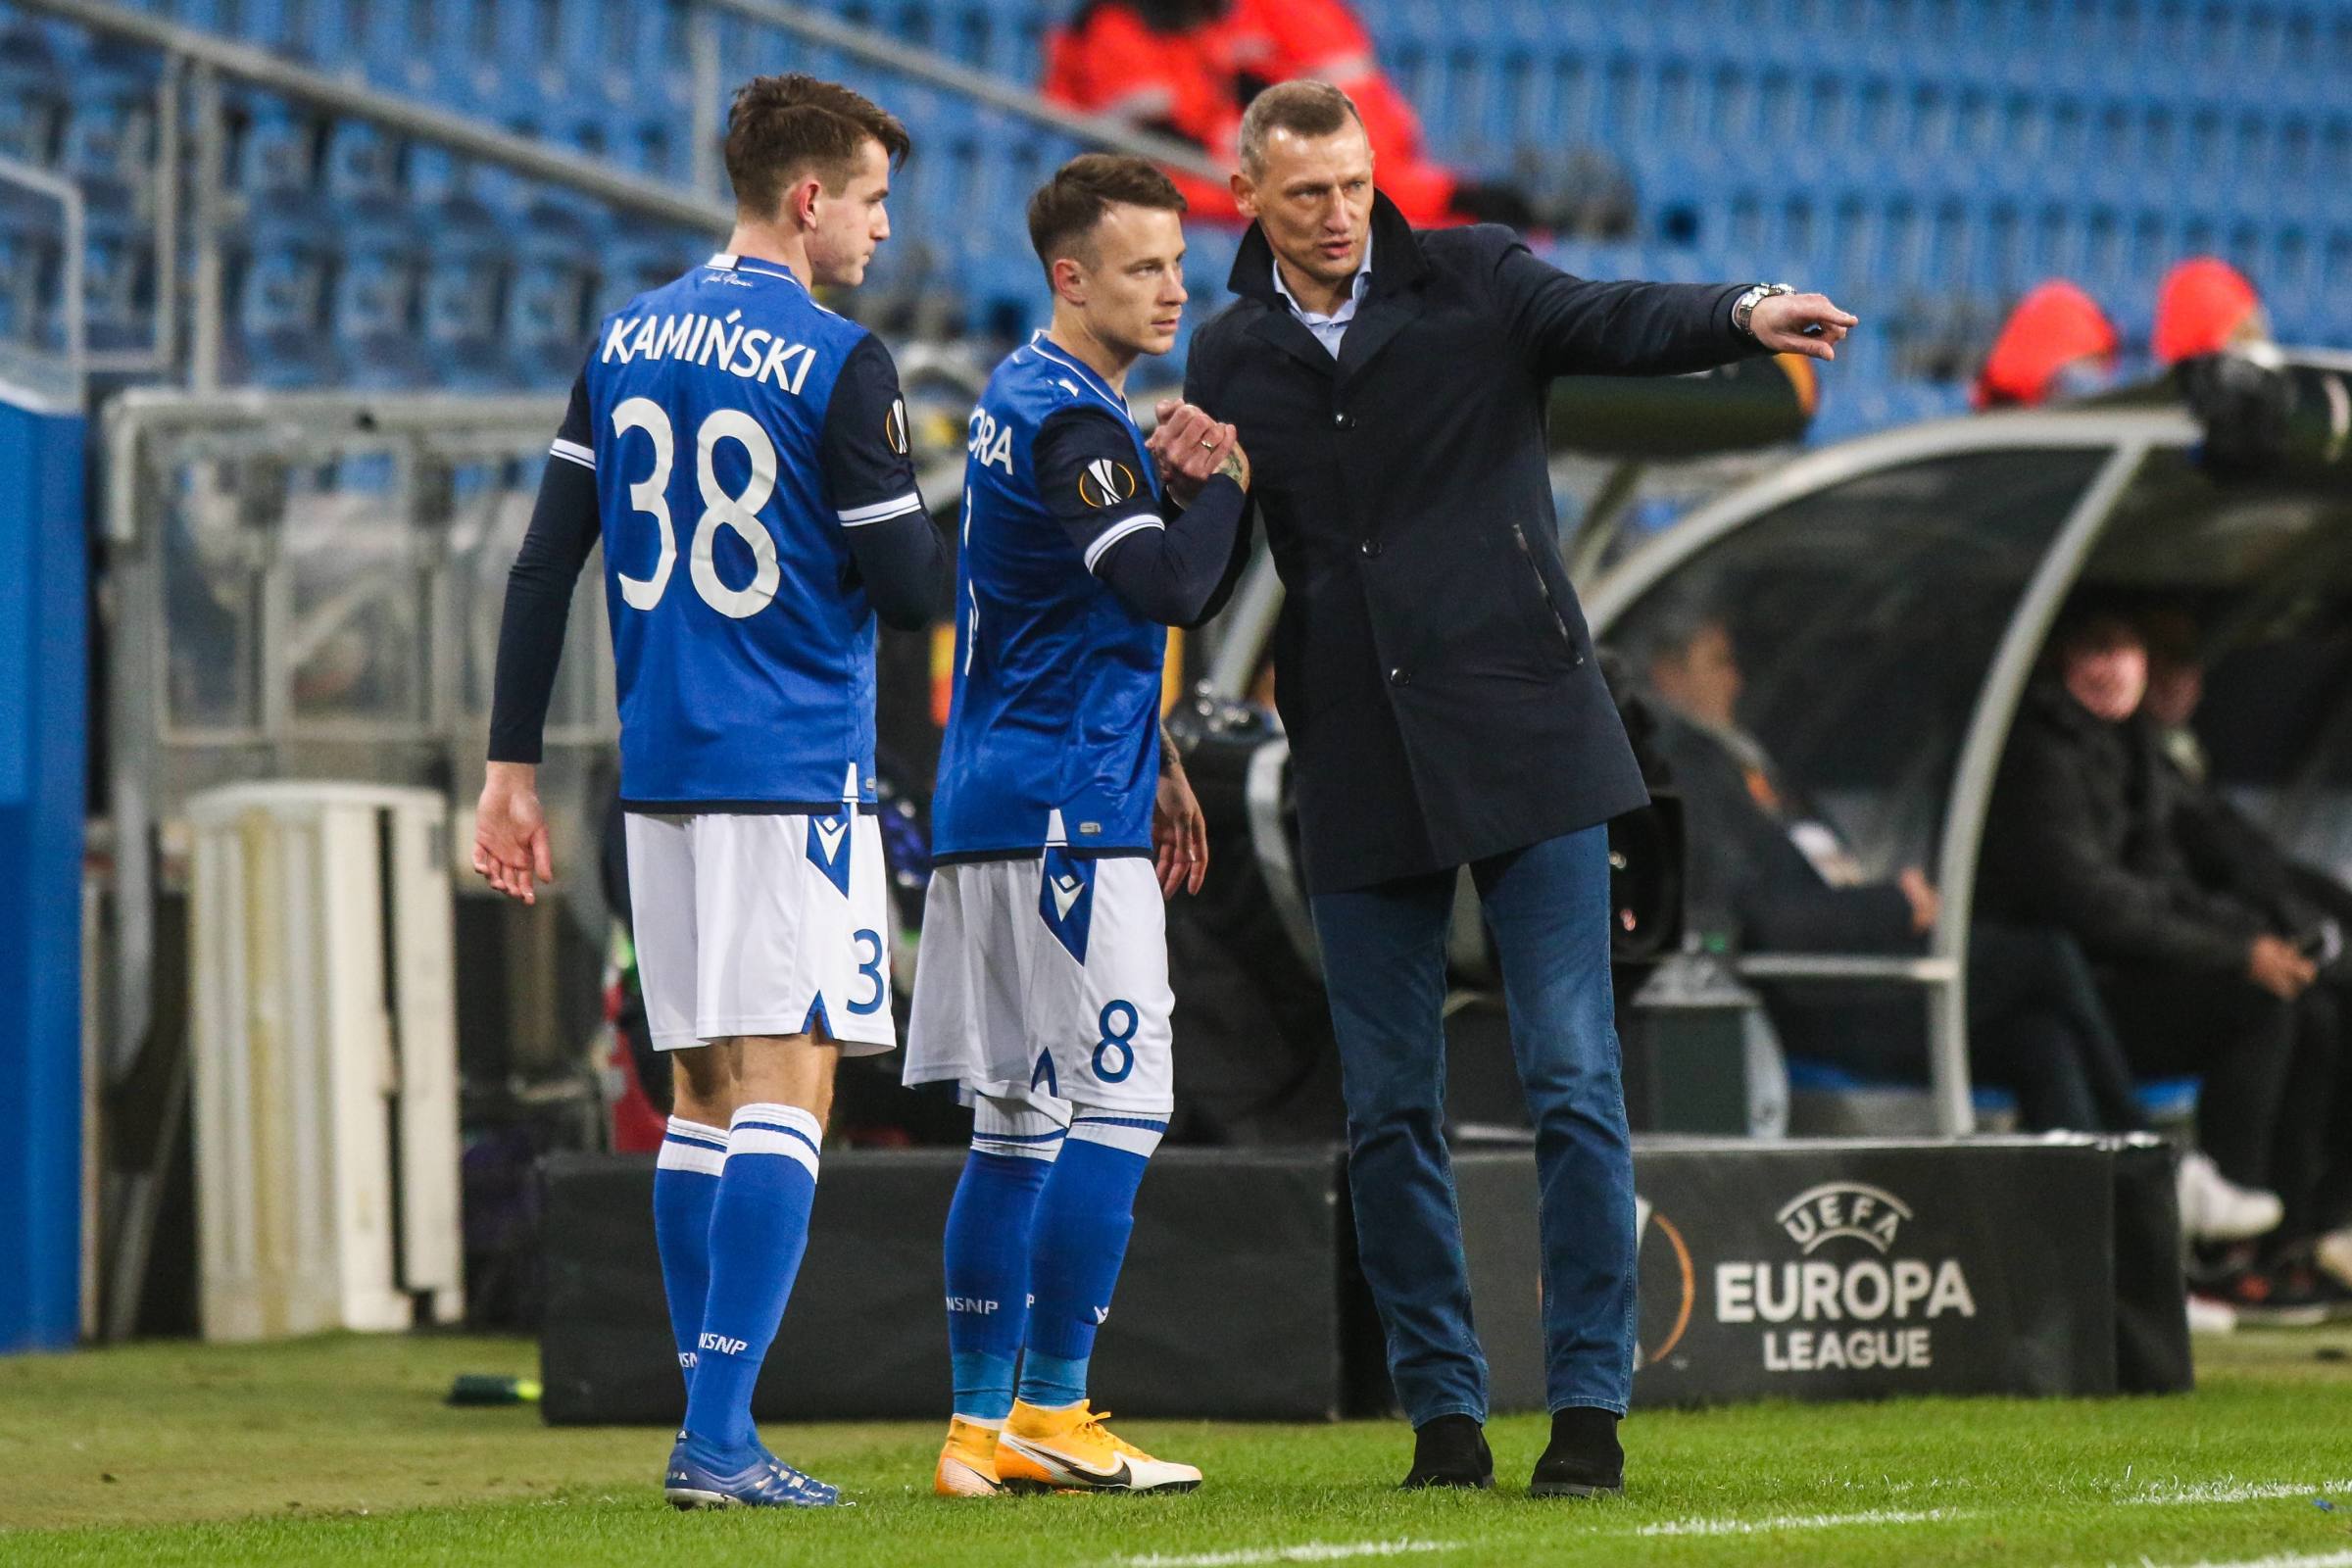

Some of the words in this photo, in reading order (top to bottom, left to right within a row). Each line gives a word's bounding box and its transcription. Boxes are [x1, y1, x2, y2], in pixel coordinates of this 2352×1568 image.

[602, 309, 816, 396] KAMIŃSKI
[968, 405, 1014, 476] ORA
[611, 397, 781, 619] 38
[846, 928, 892, 1015] 3
[1091, 999, 1139, 1084] 8
[1784, 1195, 1900, 1245] UEFA
[1715, 1259, 1976, 1324] EUROPA
[1764, 1328, 1933, 1371] LEAGUE
